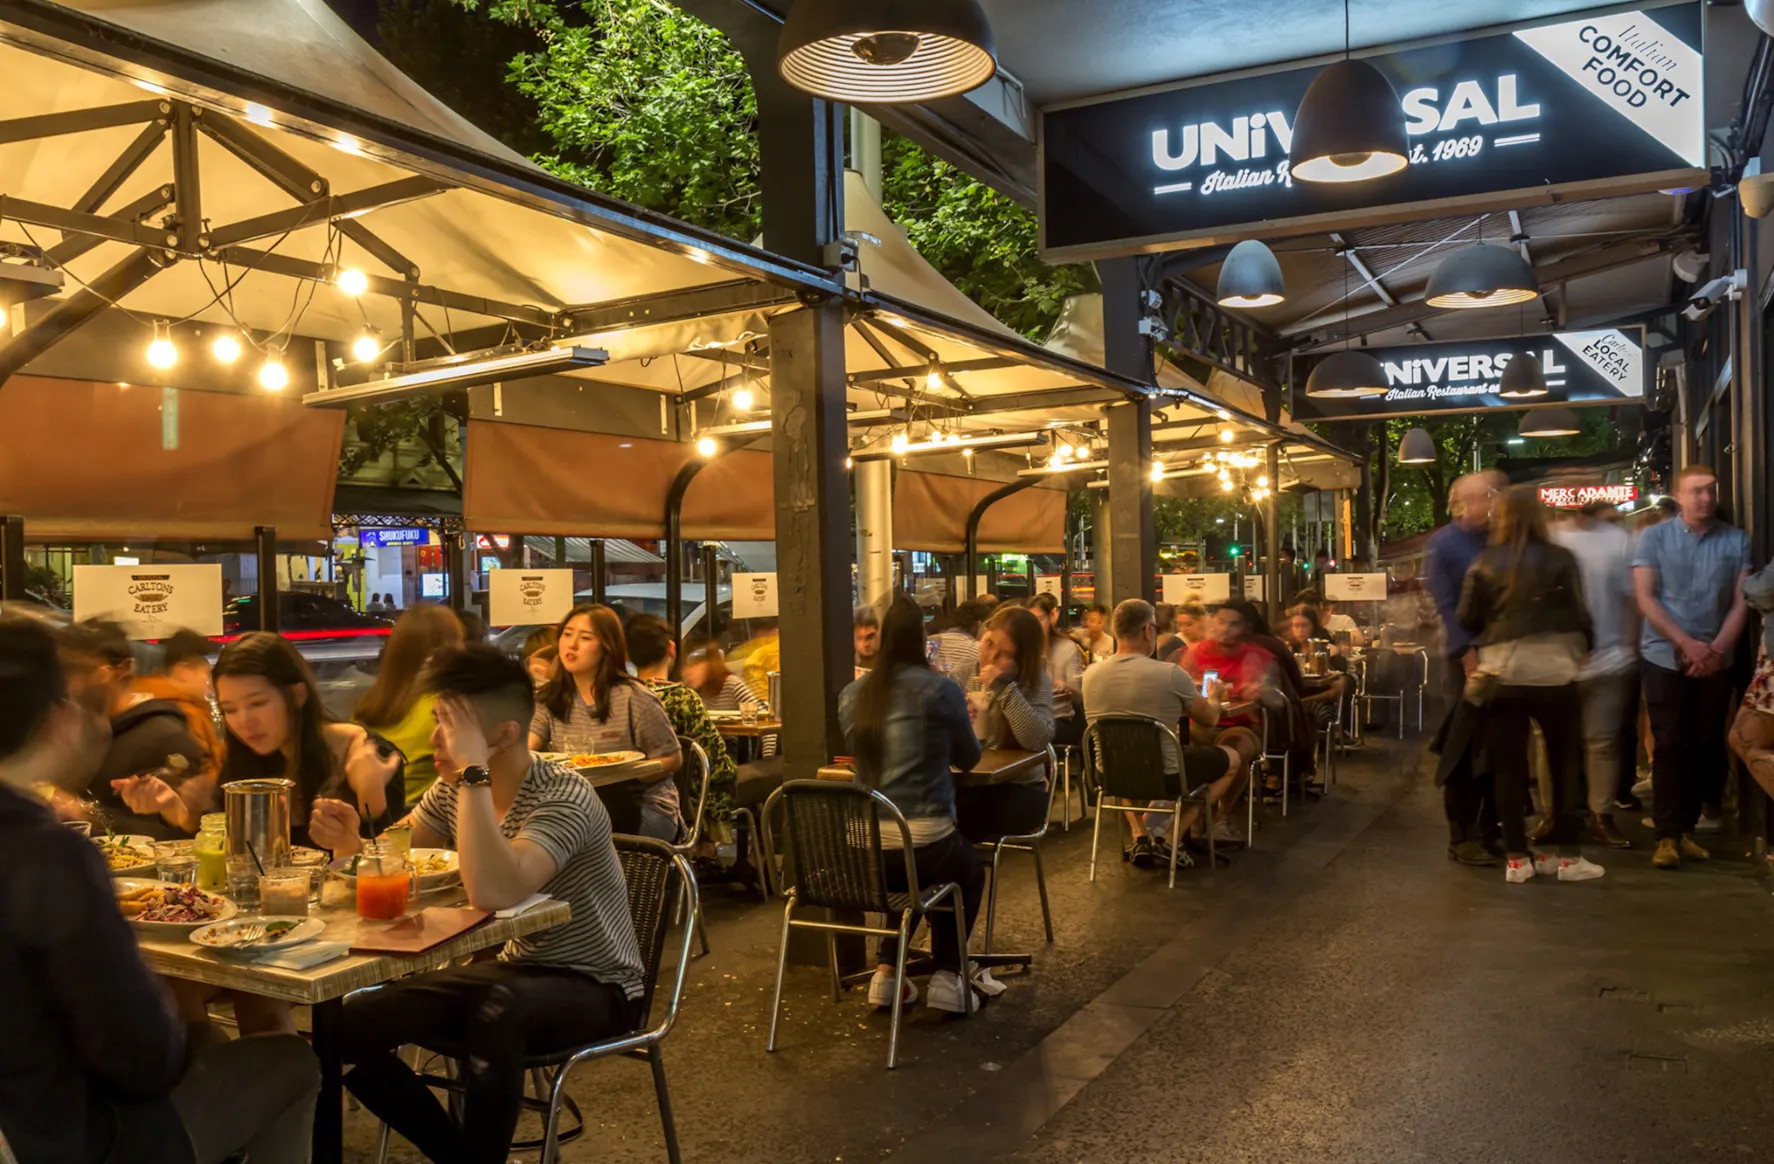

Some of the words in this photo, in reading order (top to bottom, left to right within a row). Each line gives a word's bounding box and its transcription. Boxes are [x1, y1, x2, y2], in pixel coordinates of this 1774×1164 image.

[1579, 25, 1691, 107] COMFORT
[1618, 24, 1678, 72] Italian
[1582, 56, 1647, 108] FOOD
[1200, 168, 1275, 195] Italian
[1432, 135, 1483, 162] 1969
[1582, 345, 1627, 381] EATERY
[1593, 339, 1630, 373] LOCAL
[1385, 384, 1427, 401] Italian
[1427, 382, 1488, 400] Restaurant
[378, 529, 420, 541] SHUKUFUKU
[133, 602, 168, 614] EATERY
